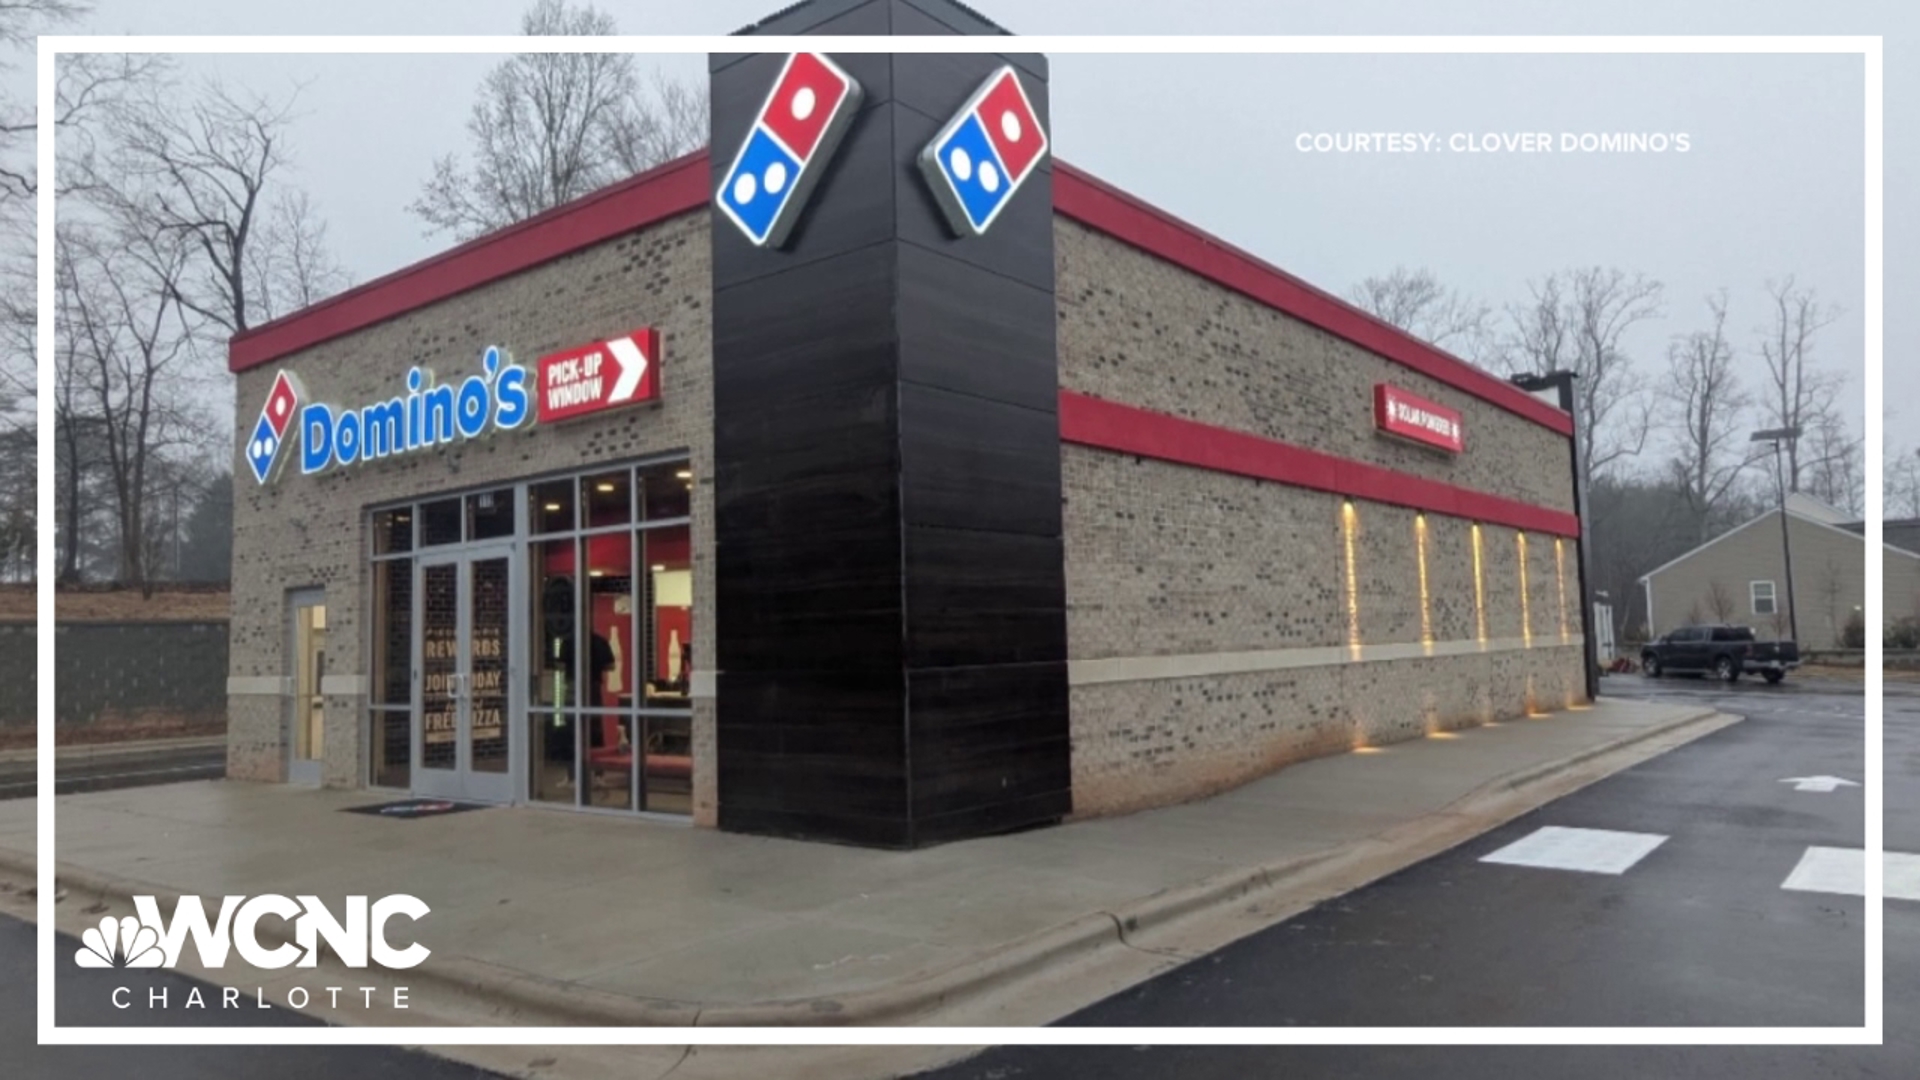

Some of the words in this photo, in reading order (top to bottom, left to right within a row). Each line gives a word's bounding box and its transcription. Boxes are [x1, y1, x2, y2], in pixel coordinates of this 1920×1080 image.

[548, 352, 602, 387] PICK-UP
[301, 344, 529, 475] Domino's
[548, 376, 602, 410] WINDOW
[426, 639, 500, 658] REWRDS
